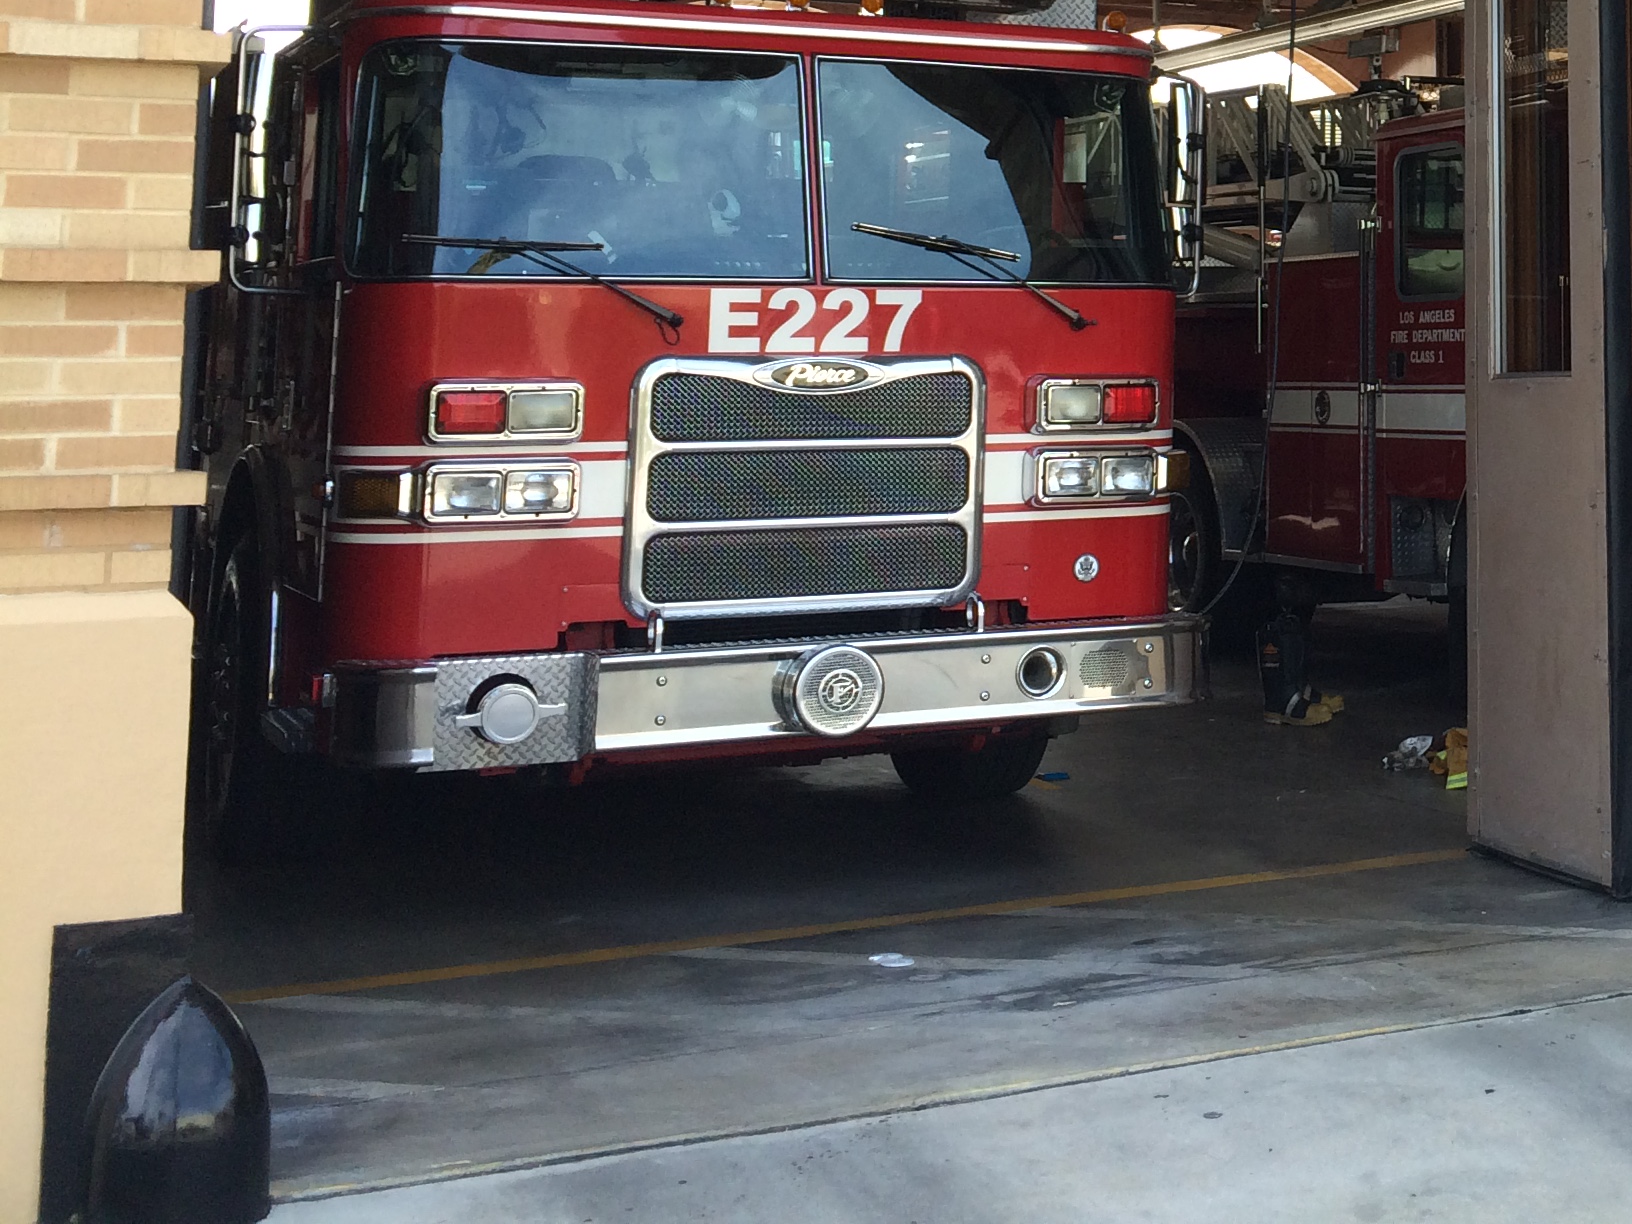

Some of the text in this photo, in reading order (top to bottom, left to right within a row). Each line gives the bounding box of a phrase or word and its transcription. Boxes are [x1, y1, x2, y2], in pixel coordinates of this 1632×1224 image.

[708, 287, 923, 353] E227
[1399, 309, 1455, 324] LOS ANGELES
[1390, 328, 1465, 344] FIRE DEPARTMENT
[1410, 350, 1444, 364] CLASS 1
[785, 364, 856, 387] Pierce
